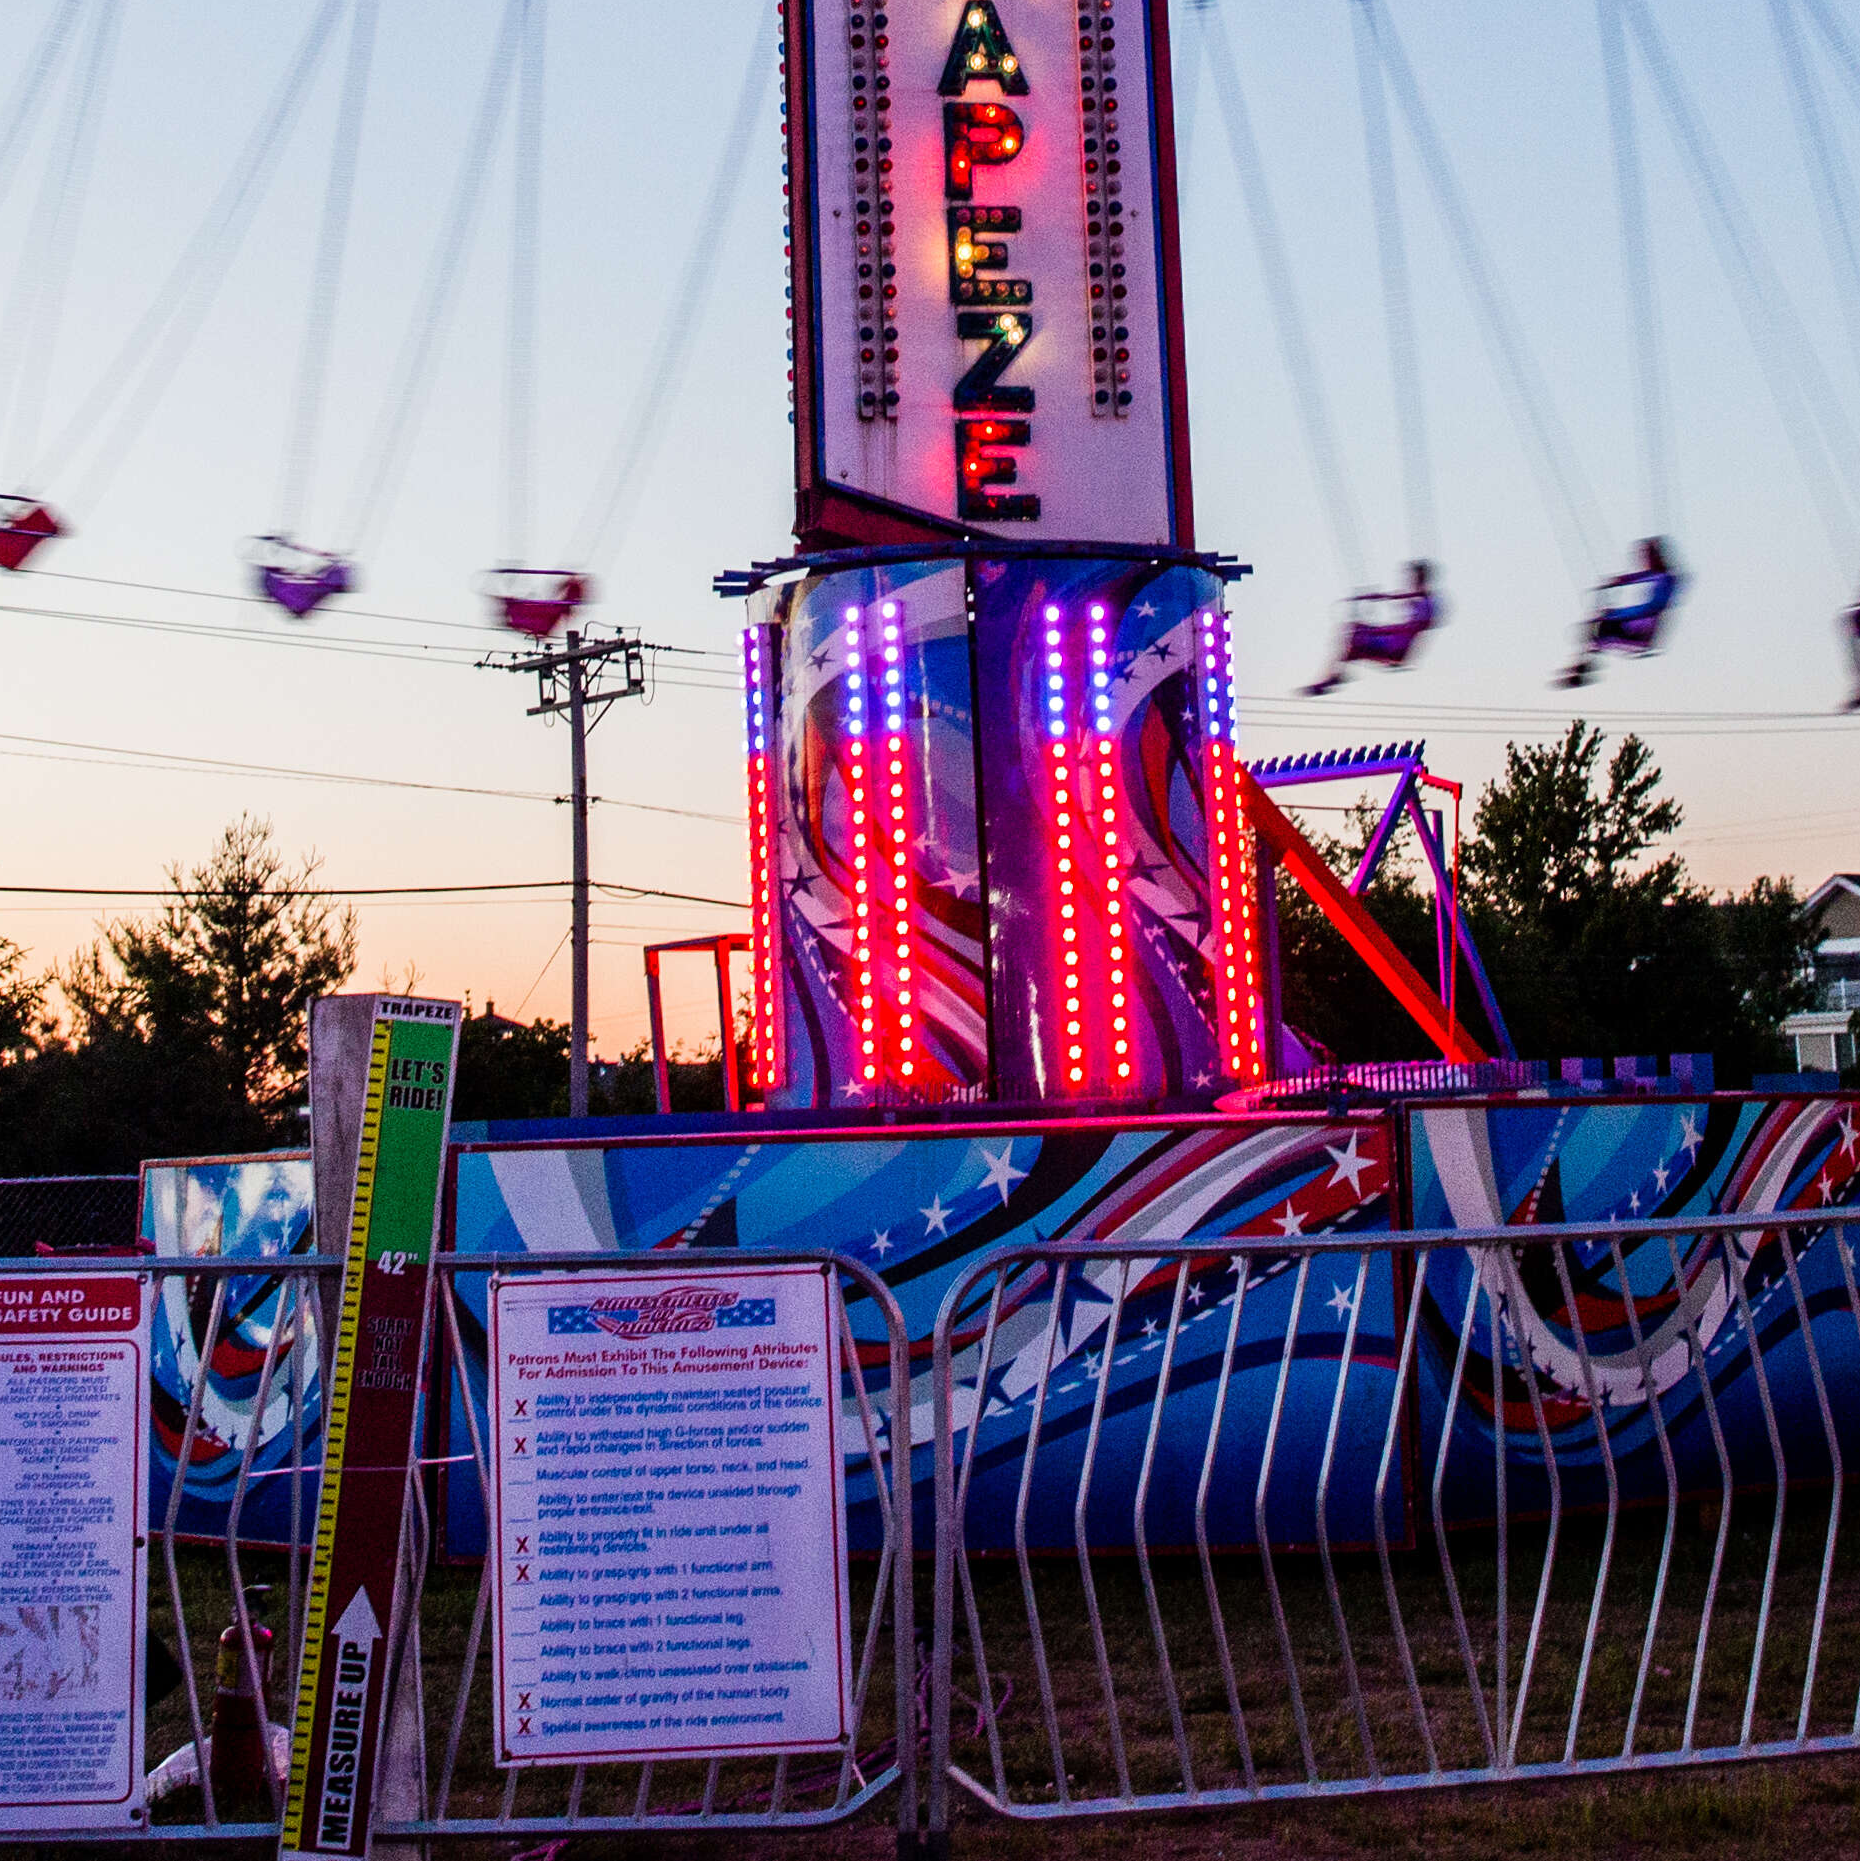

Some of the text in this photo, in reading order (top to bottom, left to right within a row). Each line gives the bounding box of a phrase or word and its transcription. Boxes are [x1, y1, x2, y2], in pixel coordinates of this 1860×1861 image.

[380, 1001, 453, 1020] TRAPEZE
[390, 1058, 445, 1084] LET'S
[389, 1085, 444, 1111] RIDE!
[377, 1250, 418, 1275] 42"
[40, 1289, 85, 1303] AND
[68, 1306, 132, 1321] GUIDE
[366, 1316, 412, 1336] SORRY
[372, 1335, 403, 1353] NOT
[508, 1341, 817, 1365] Patrons Must Exhibit The Following Attributes
[38, 1351, 124, 1361] RESTRICTIONS
[371, 1353, 402, 1372] TALL
[13, 1363, 105, 1373] AND WARNINGS
[518, 1367, 540, 1379] For
[545, 1364, 616, 1378] Admission
[641, 1362, 668, 1375] This
[672, 1359, 754, 1374] Amusement
[759, 1357, 807, 1370] Device:
[356, 1370, 413, 1390] ENOUGH
[321, 1641, 367, 1843] MEASURE UP
